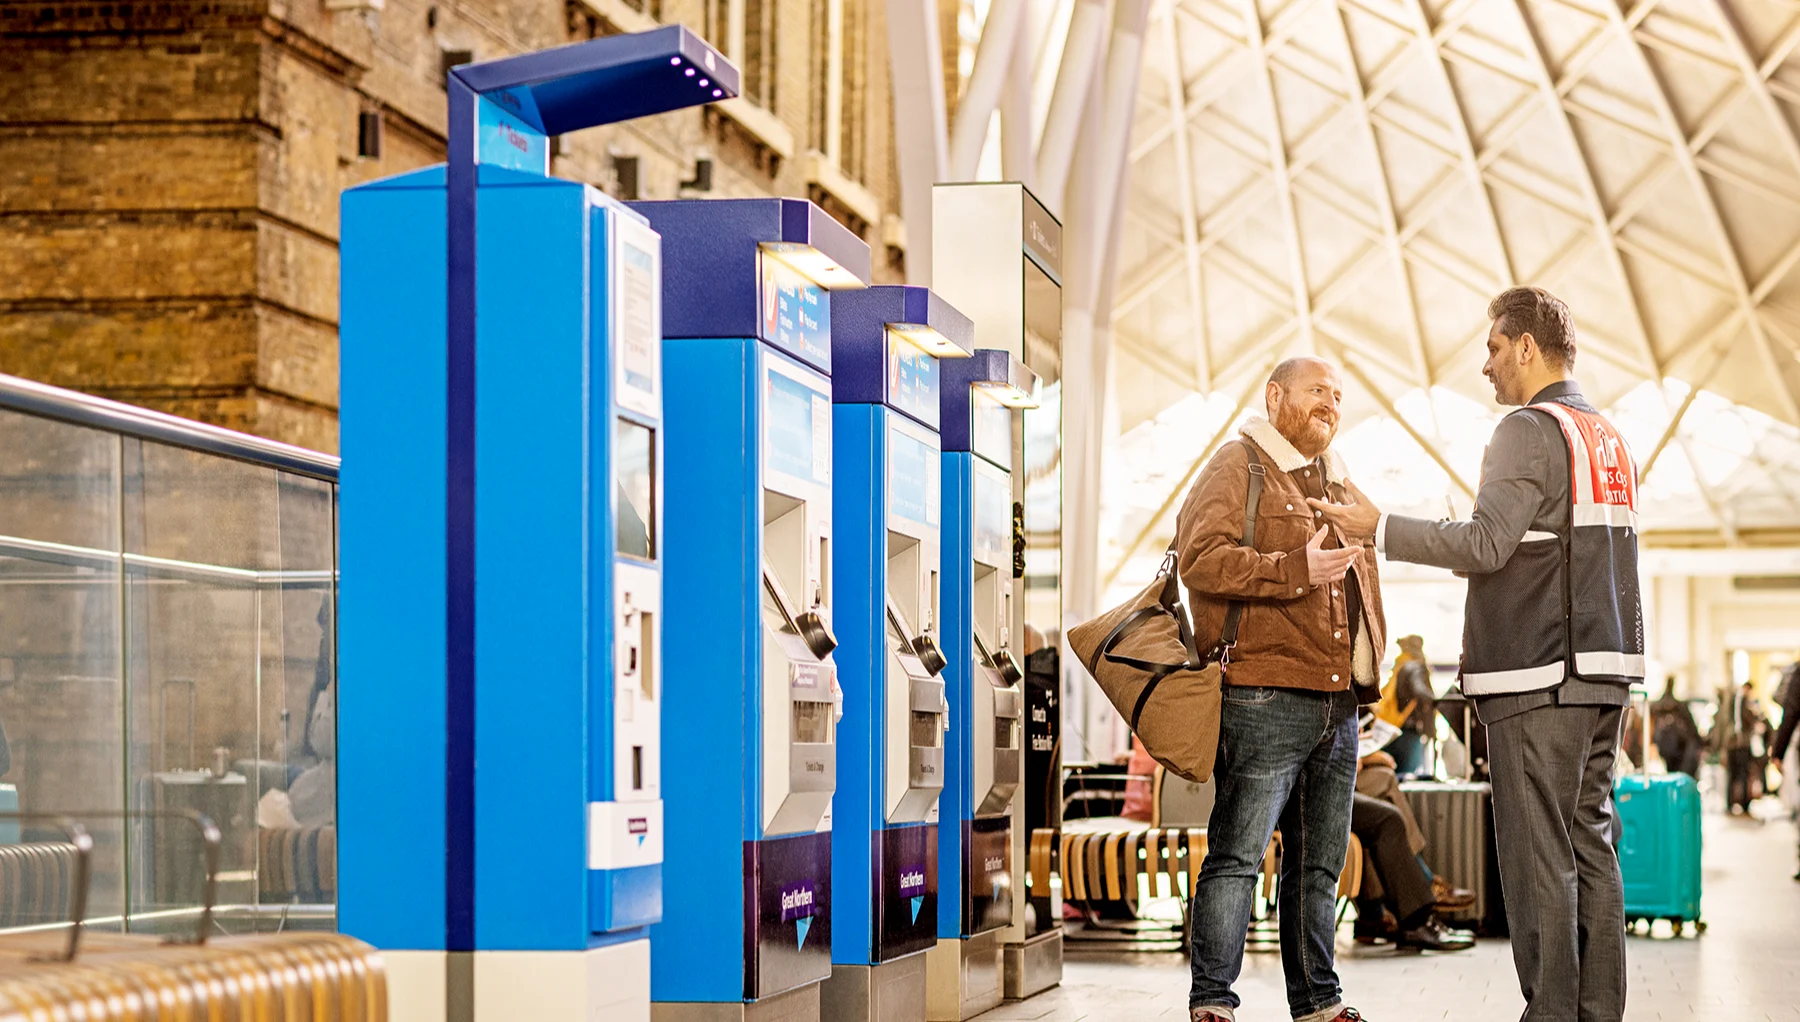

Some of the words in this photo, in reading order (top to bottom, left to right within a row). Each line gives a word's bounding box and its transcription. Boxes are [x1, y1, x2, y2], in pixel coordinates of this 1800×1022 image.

[900, 872, 909, 889] Great
[909, 870, 924, 887] Northern
[781, 891, 794, 911] Great
[793, 885, 812, 908] Northern
